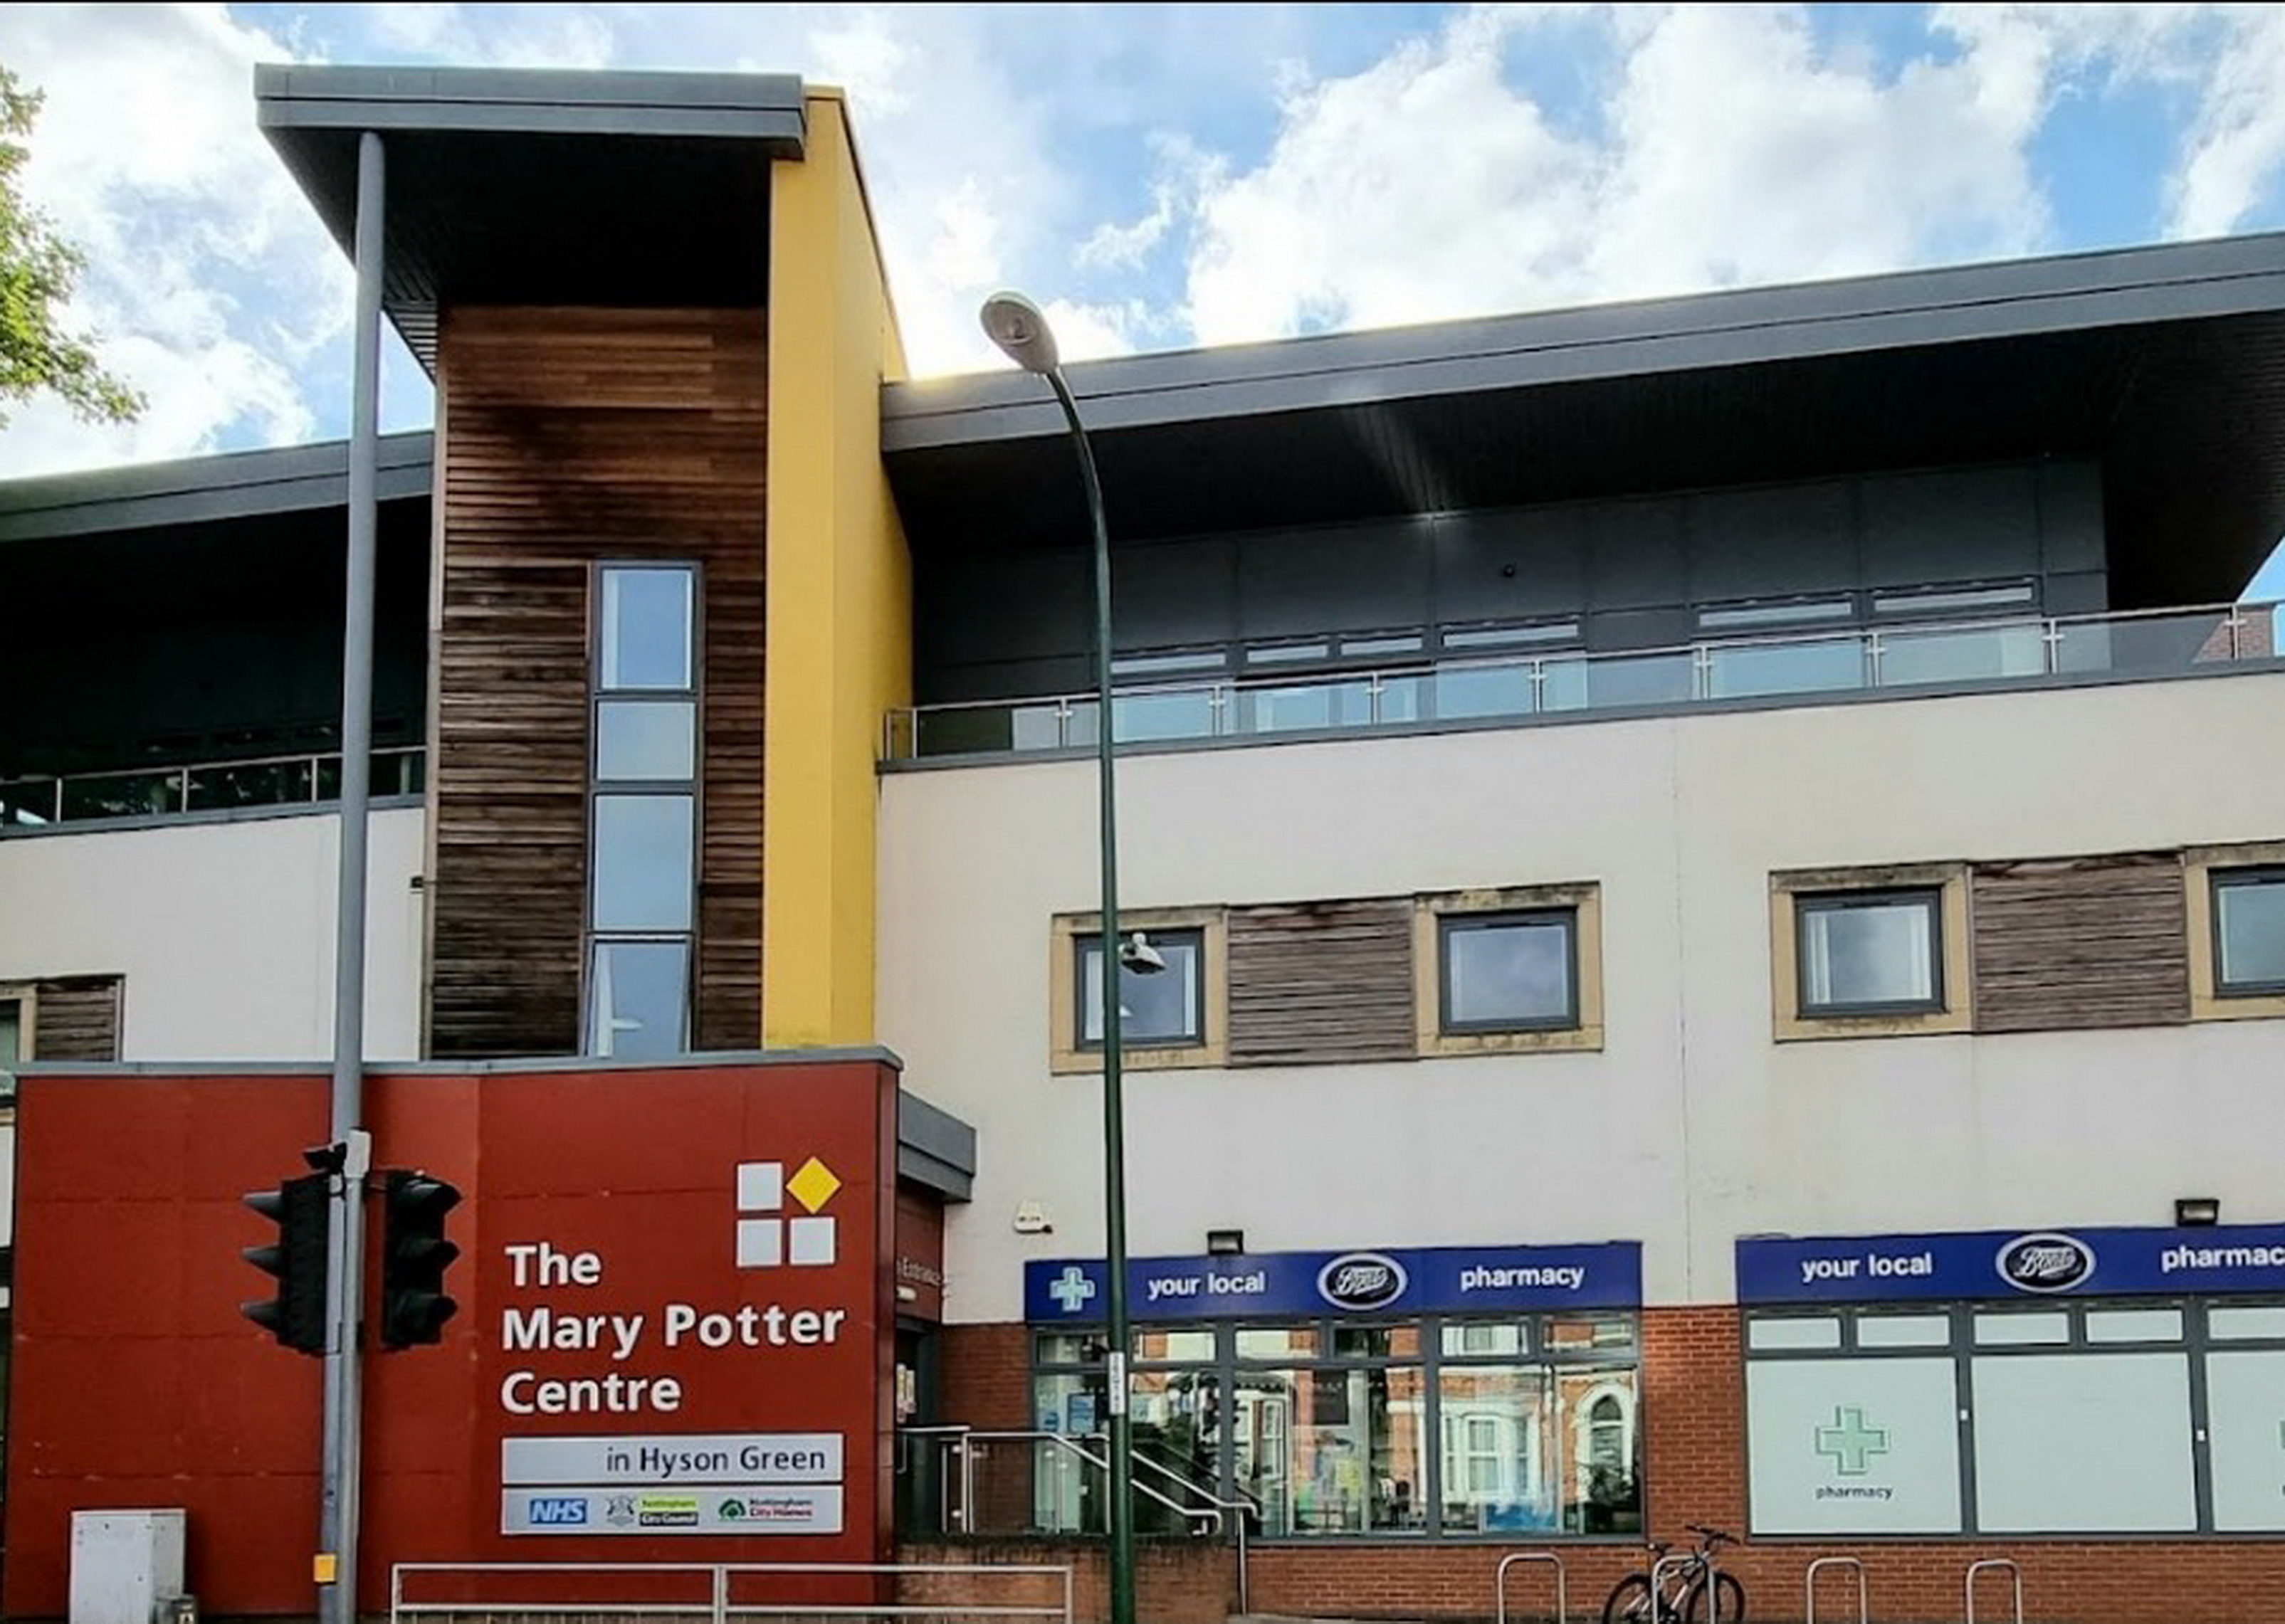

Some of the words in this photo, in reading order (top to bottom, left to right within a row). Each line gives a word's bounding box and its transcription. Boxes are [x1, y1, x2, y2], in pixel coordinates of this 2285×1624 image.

[504, 1241, 602, 1286] The
[1801, 1258, 1861, 1283] your
[1868, 1251, 1933, 1276] local
[1147, 1277, 1201, 1301] your
[1208, 1270, 1266, 1294] local
[1460, 1265, 1585, 1293] pharmacy
[503, 1307, 644, 1360] Mary
[664, 1303, 845, 1347] Potter
[500, 1371, 681, 1414] Centre
[606, 1446, 630, 1472] in
[639, 1446, 730, 1480] Hyson
[739, 1445, 826, 1471] Green
[1815, 1485, 1893, 1501] pharmacy
[530, 1499, 585, 1524] NHS
